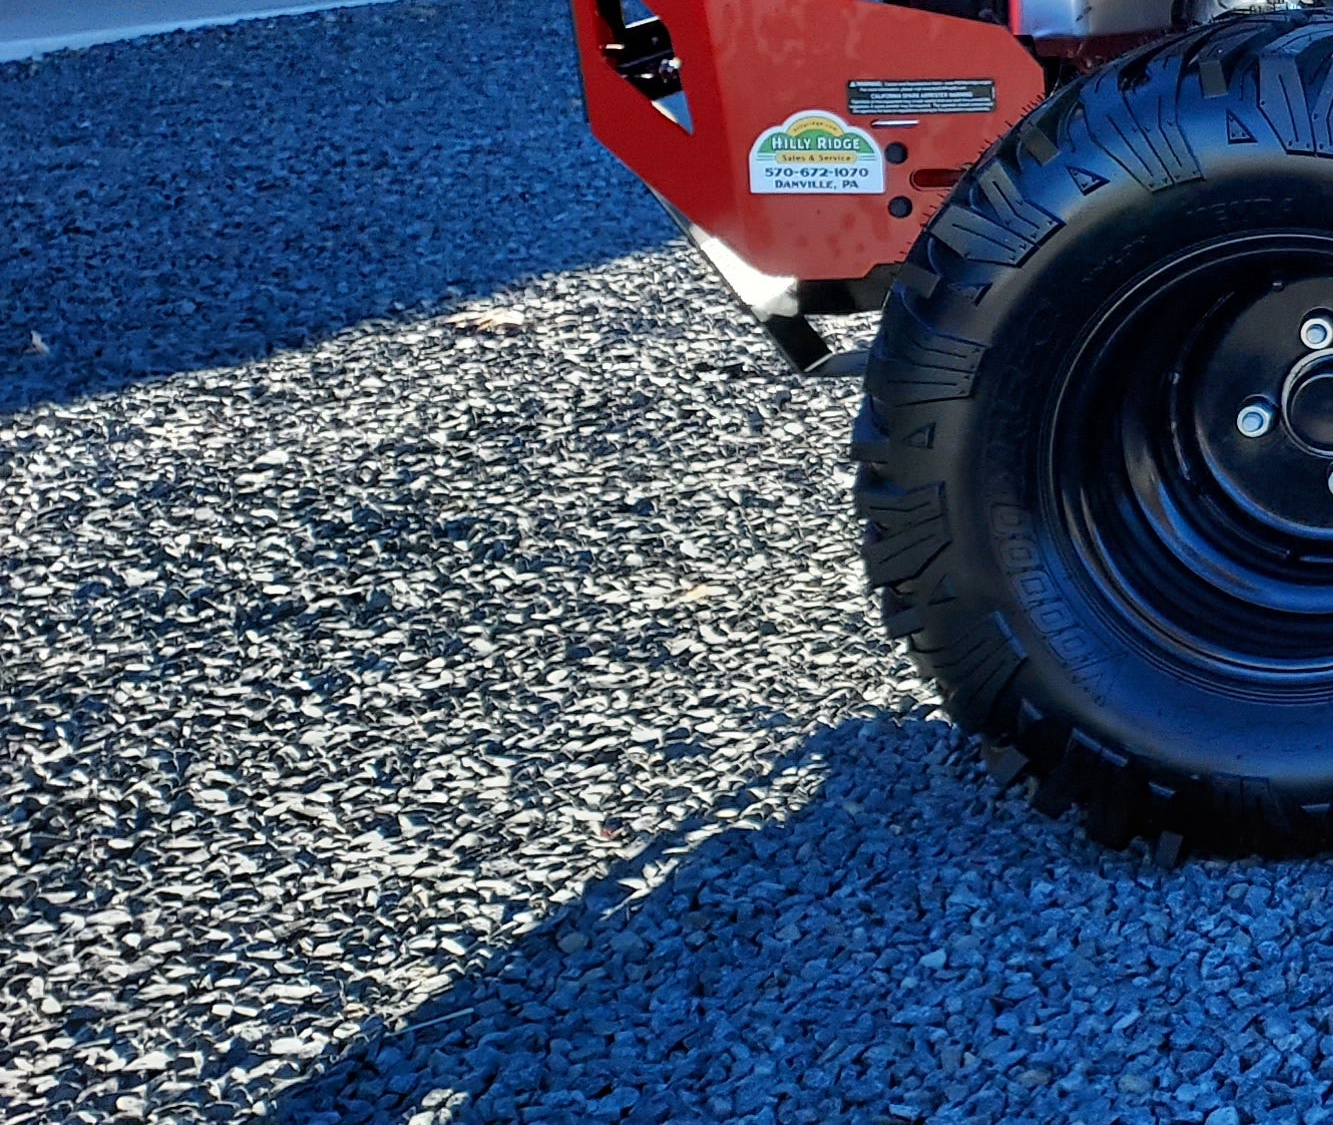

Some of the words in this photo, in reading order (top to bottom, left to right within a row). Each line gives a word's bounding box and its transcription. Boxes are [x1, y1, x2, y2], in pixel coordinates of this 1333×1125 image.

[782, 154, 806, 162] Sales
[765, 167, 869, 178] 570-672-1070
[842, 179, 859, 189] PA
